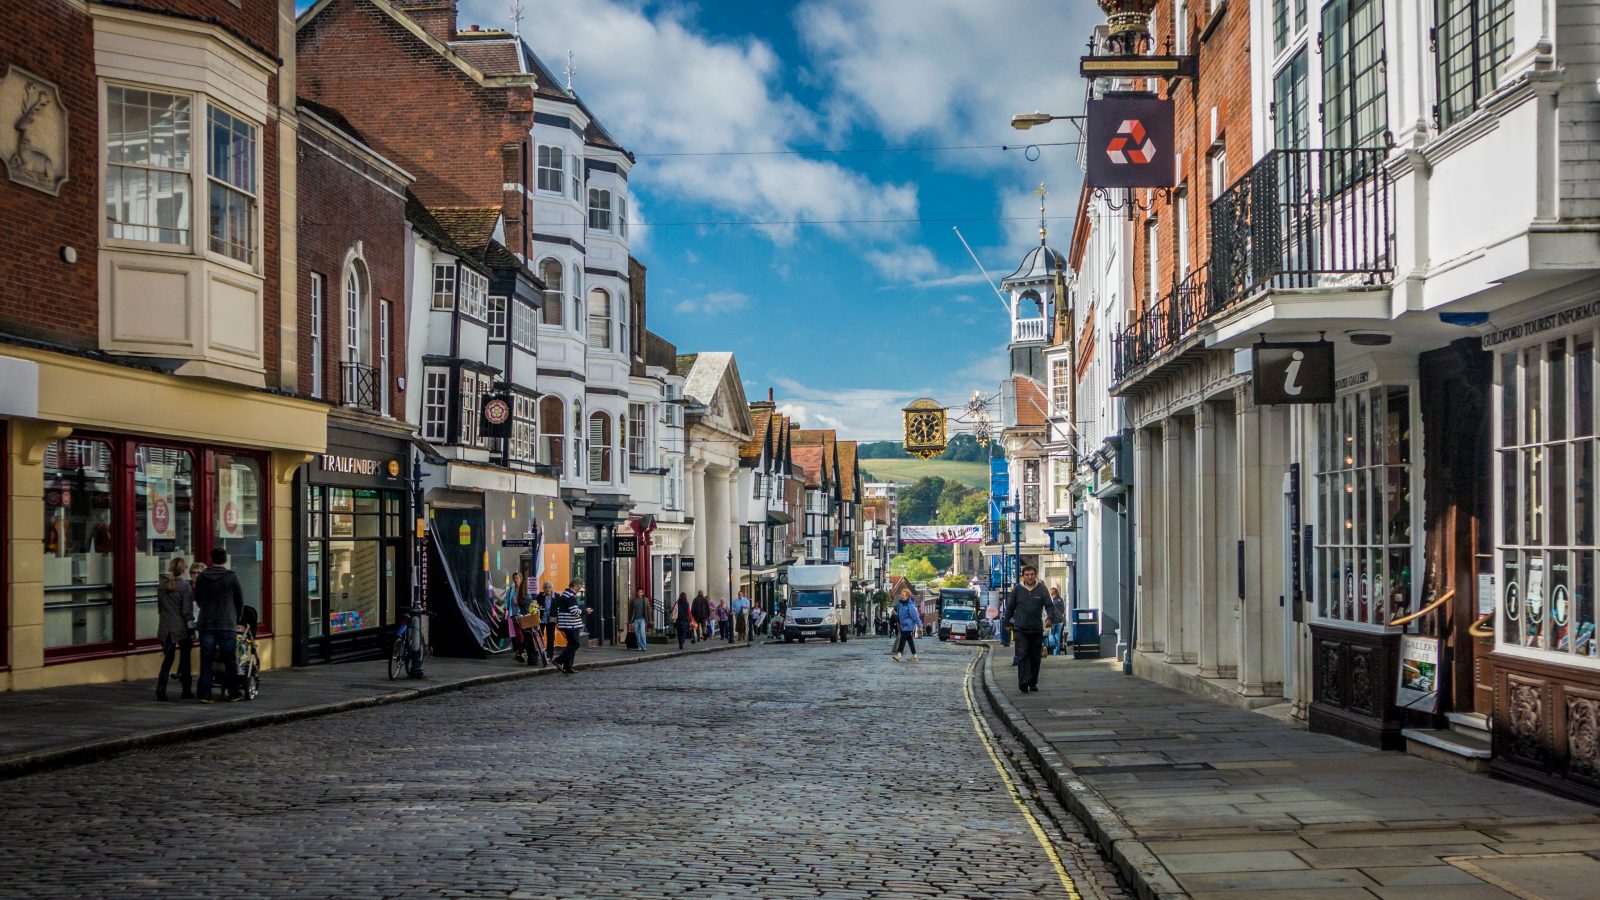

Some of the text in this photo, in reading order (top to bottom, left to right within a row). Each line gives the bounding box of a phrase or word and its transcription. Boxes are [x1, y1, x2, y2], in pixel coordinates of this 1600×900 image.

[1483, 325, 1523, 347] GUILDFORD
[1524, 314, 1556, 336] TOURIST
[322, 454, 382, 475] TRAILFINDERS
[1405, 640, 1438, 653] GALLERY
